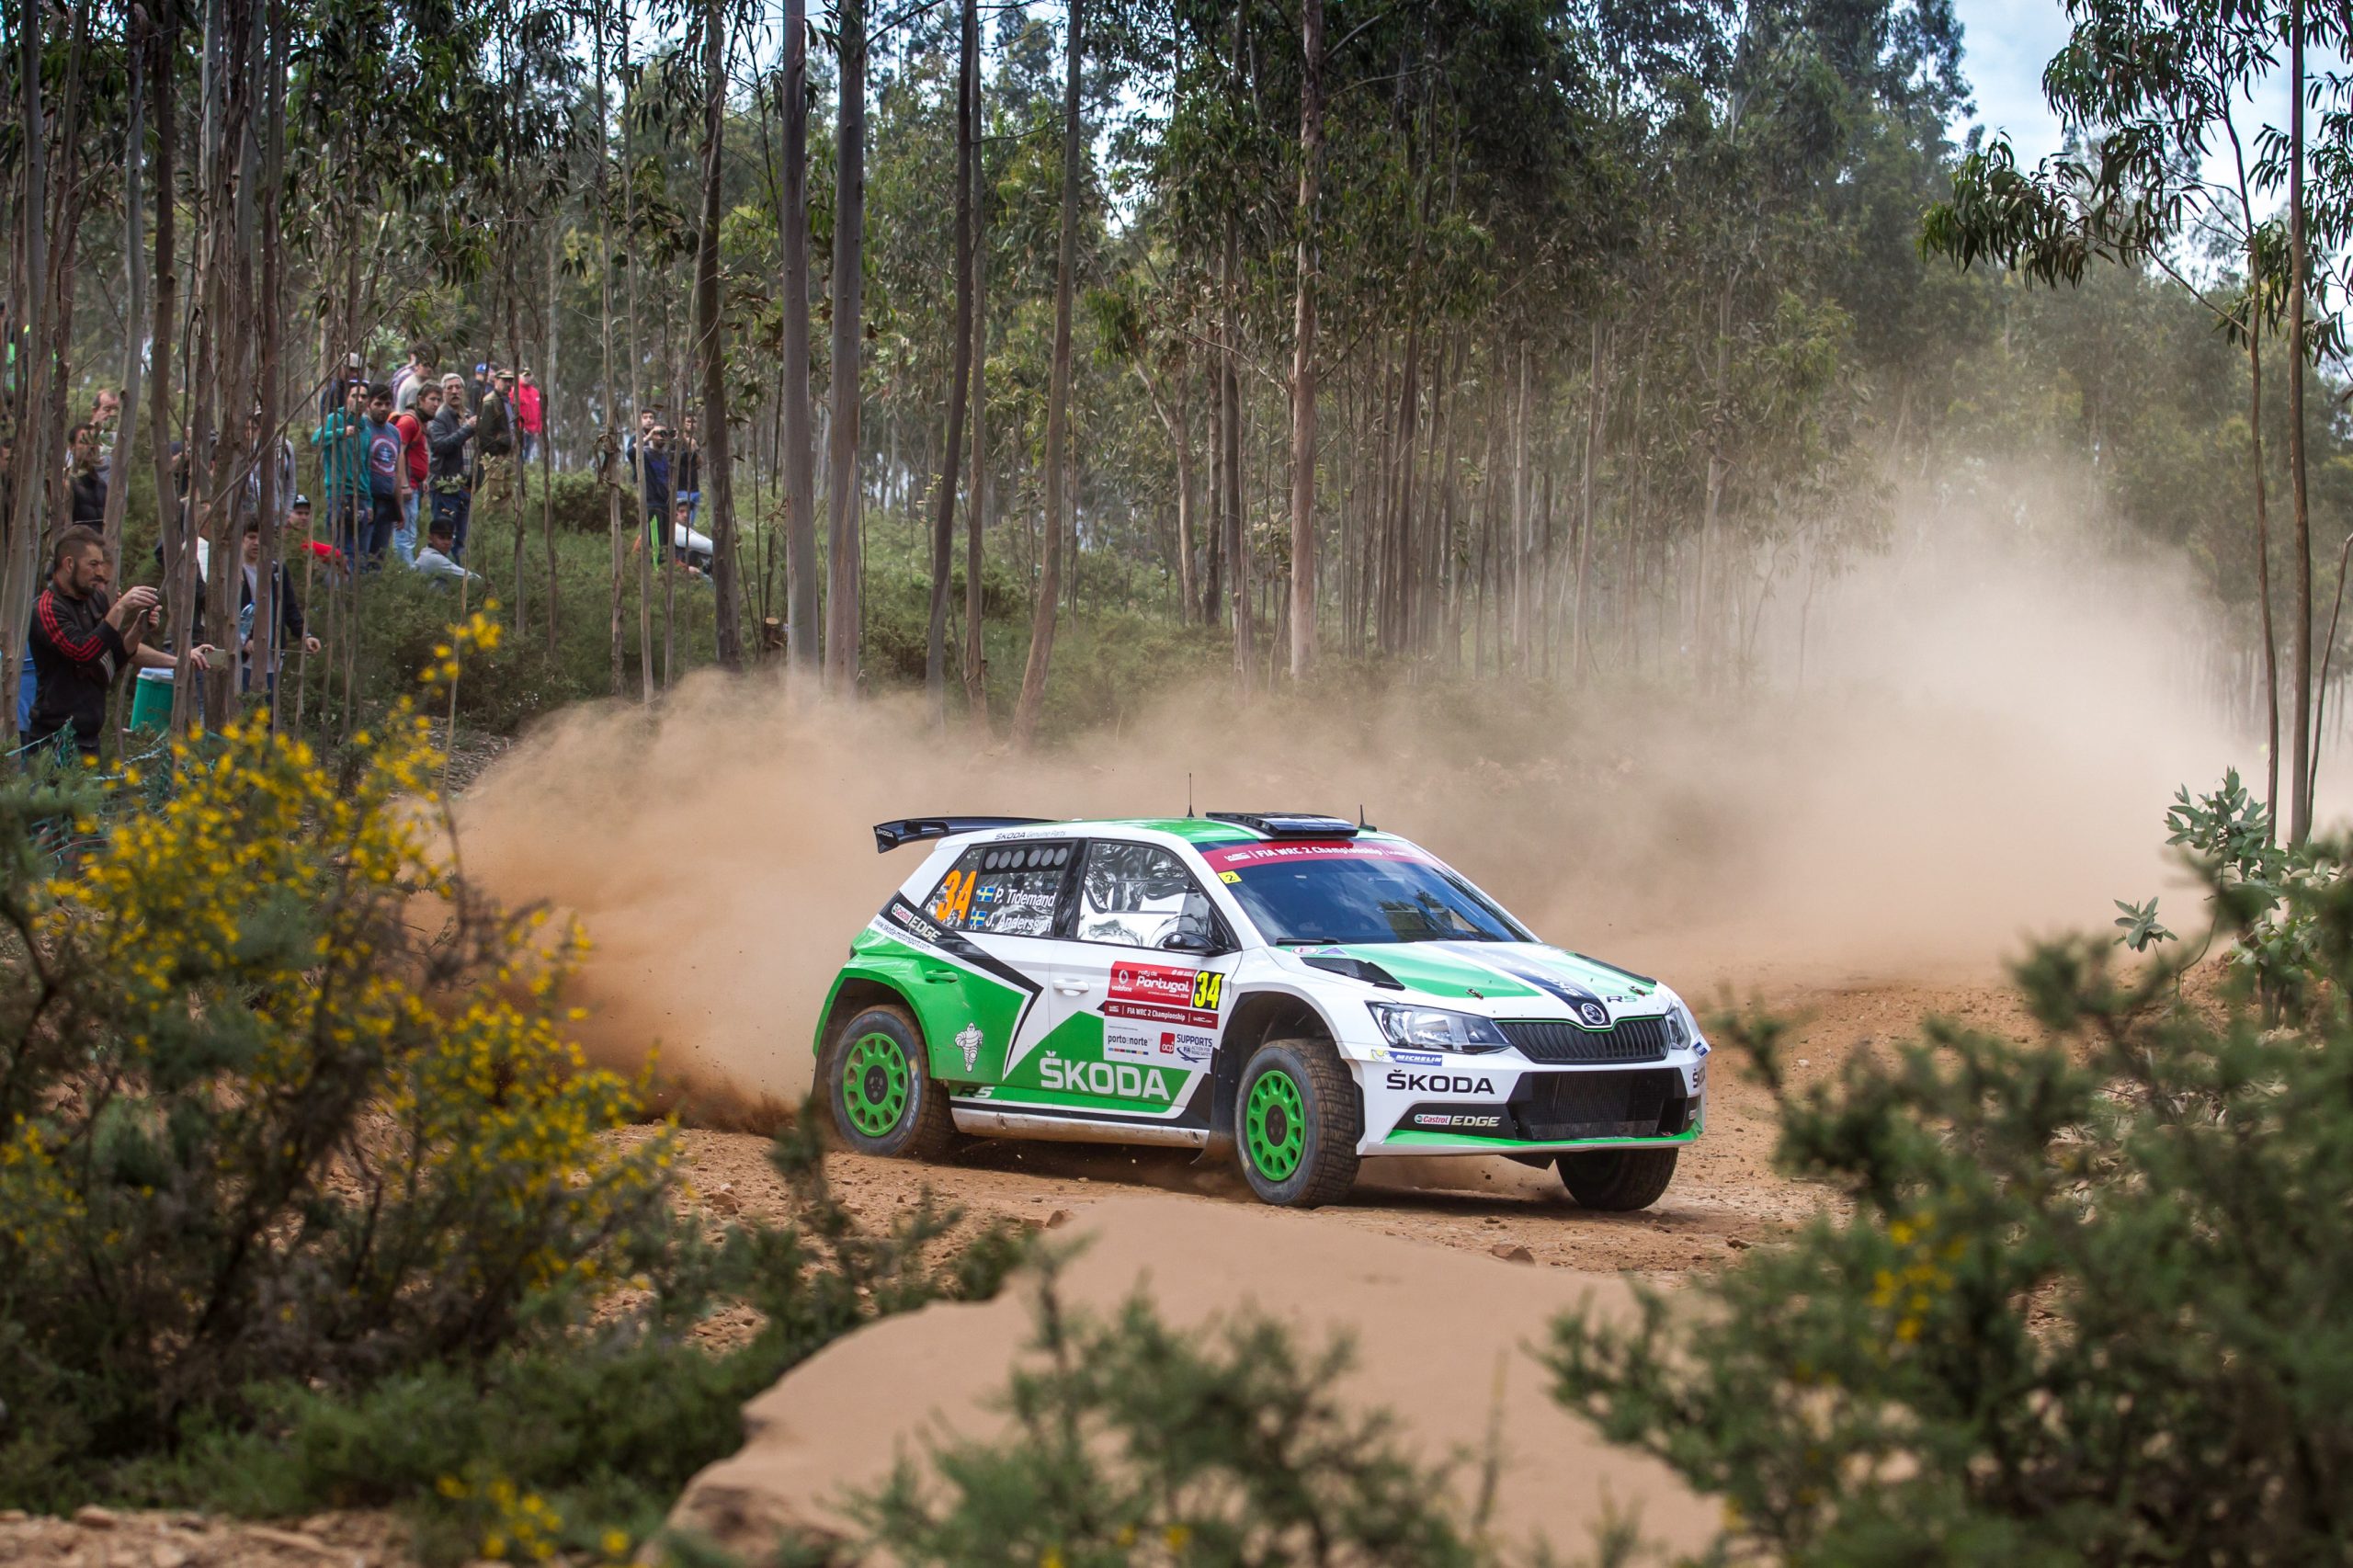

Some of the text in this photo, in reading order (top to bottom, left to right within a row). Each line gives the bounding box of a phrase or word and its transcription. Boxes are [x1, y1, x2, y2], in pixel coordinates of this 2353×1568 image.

[1256, 849, 1279, 858] FIA
[1275, 847, 1303, 856] WRC
[1312, 846, 1383, 856] Championship
[936, 869, 978, 922] 34
[994, 888, 1057, 907] P. Tidemand
[908, 915, 943, 942] EDGE
[985, 913, 1052, 932] J. Andersson
[1136, 976, 1189, 994] Portugal
[1194, 971, 1222, 1009] 34
[1136, 1008, 1147, 1017] WRC
[1152, 1010, 1186, 1022] Championship
[1108, 1035, 1148, 1046] porto norte
[1176, 1034, 1213, 1047] SUPPORTS
[1395, 1054, 1442, 1063] MICHELIN
[1040, 1051, 1170, 1101] ŠKODA
[1386, 1069, 1495, 1095] ŠKODA
[1423, 1115, 1502, 1128] Castrol EDGE
